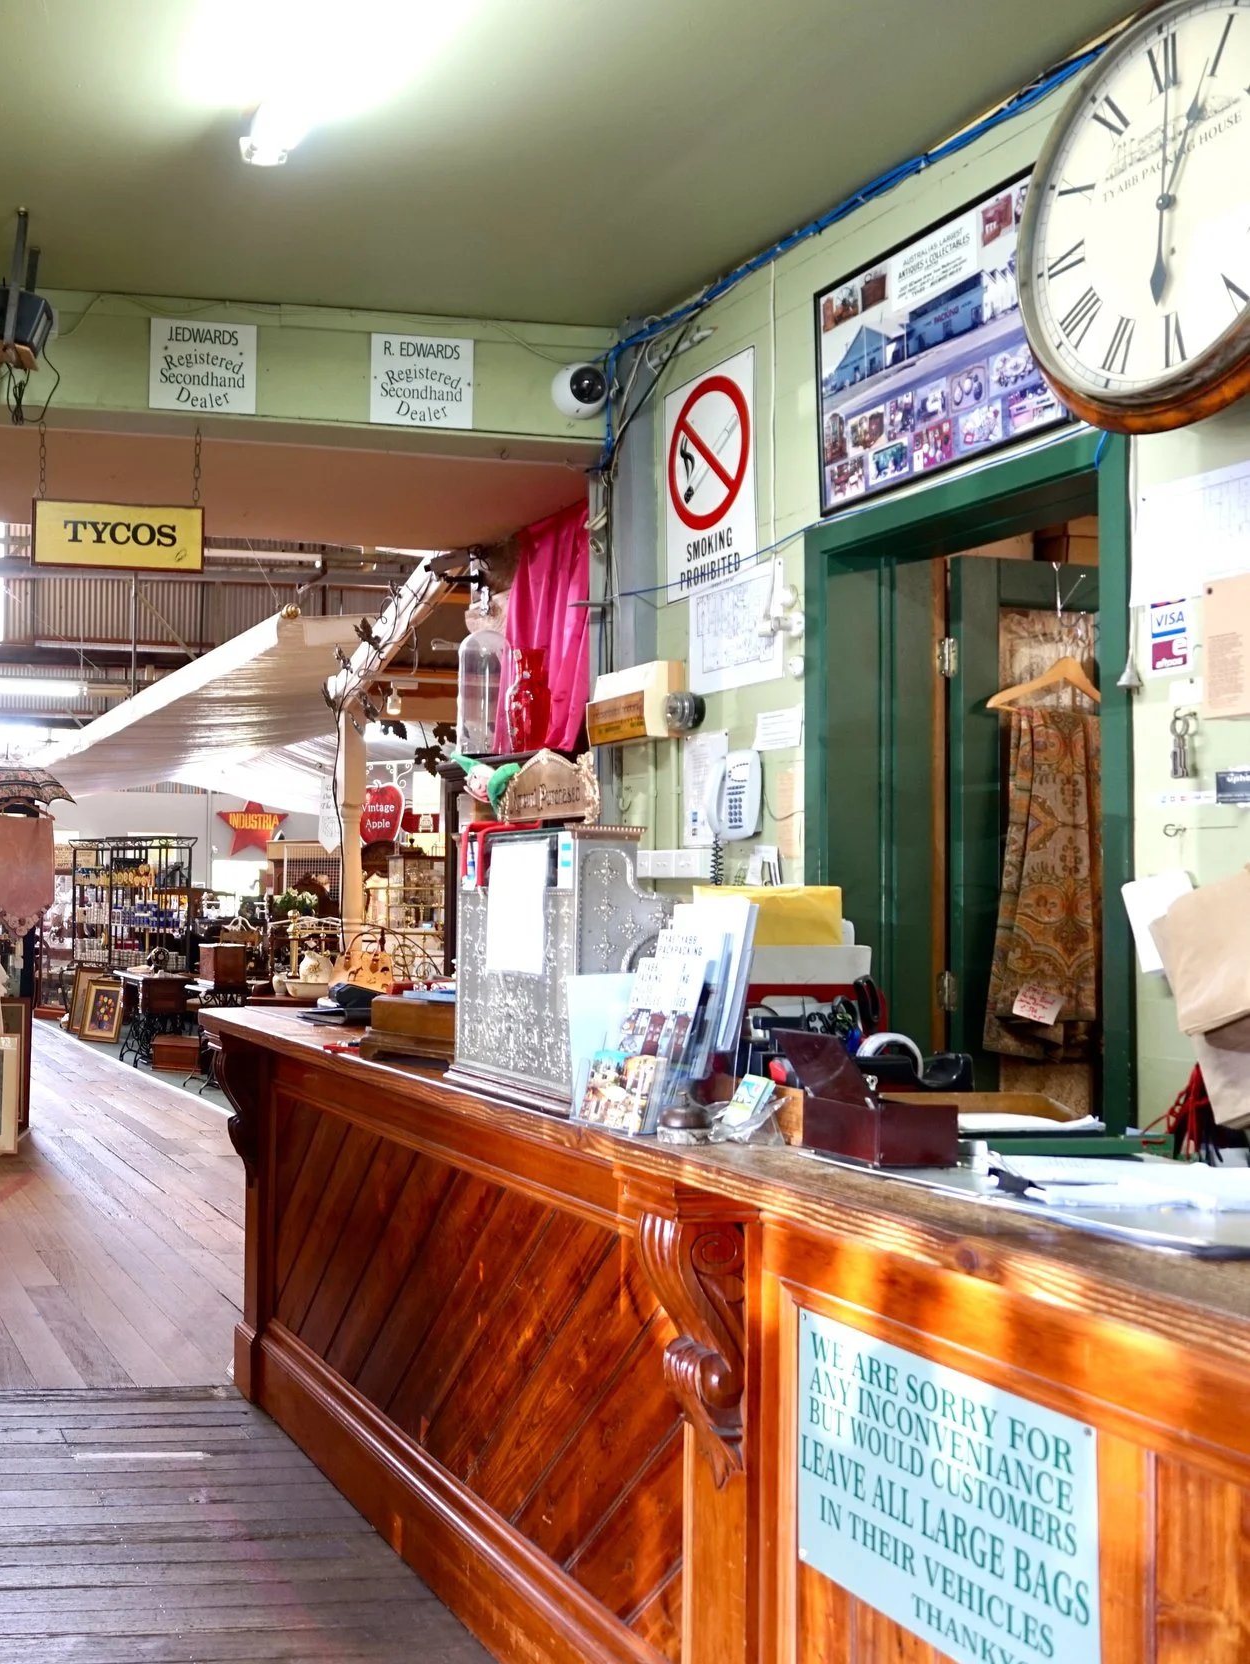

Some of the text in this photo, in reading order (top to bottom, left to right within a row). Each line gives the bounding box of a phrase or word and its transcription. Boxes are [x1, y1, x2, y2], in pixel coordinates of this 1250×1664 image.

[1103, 174, 1139, 202] TYABB
[1199, 110, 1243, 145] HOUSE
[163, 349, 244, 375] Registered
[384, 340, 460, 360] R. EDWARDS
[160, 368, 245, 388] Secondhand
[385, 364, 461, 390] Registered
[176, 386, 230, 409] Dealer
[380, 382, 462, 402] Secondhand
[396, 400, 447, 422] Dealer
[63, 520, 177, 547] TYCOS
[686, 527, 733, 563] SMOKING
[680, 552, 740, 592] PROHIBITED
[1155, 610, 1185, 627] VISA
[362, 803, 395, 813] Vintage
[366, 818, 390, 829] Apple
[810, 1331, 1075, 1476] WE ARE SORRY FOR
[810, 1366, 1074, 1515] ANY INCONVENIANCE
[809, 1395, 1077, 1558] BUT WOULD CUSTOMERS
[802, 1433, 1090, 1627] LEAVE ALL LARGE BAGS
[819, 1494, 1055, 1659] IN THEIR VEHICLES
